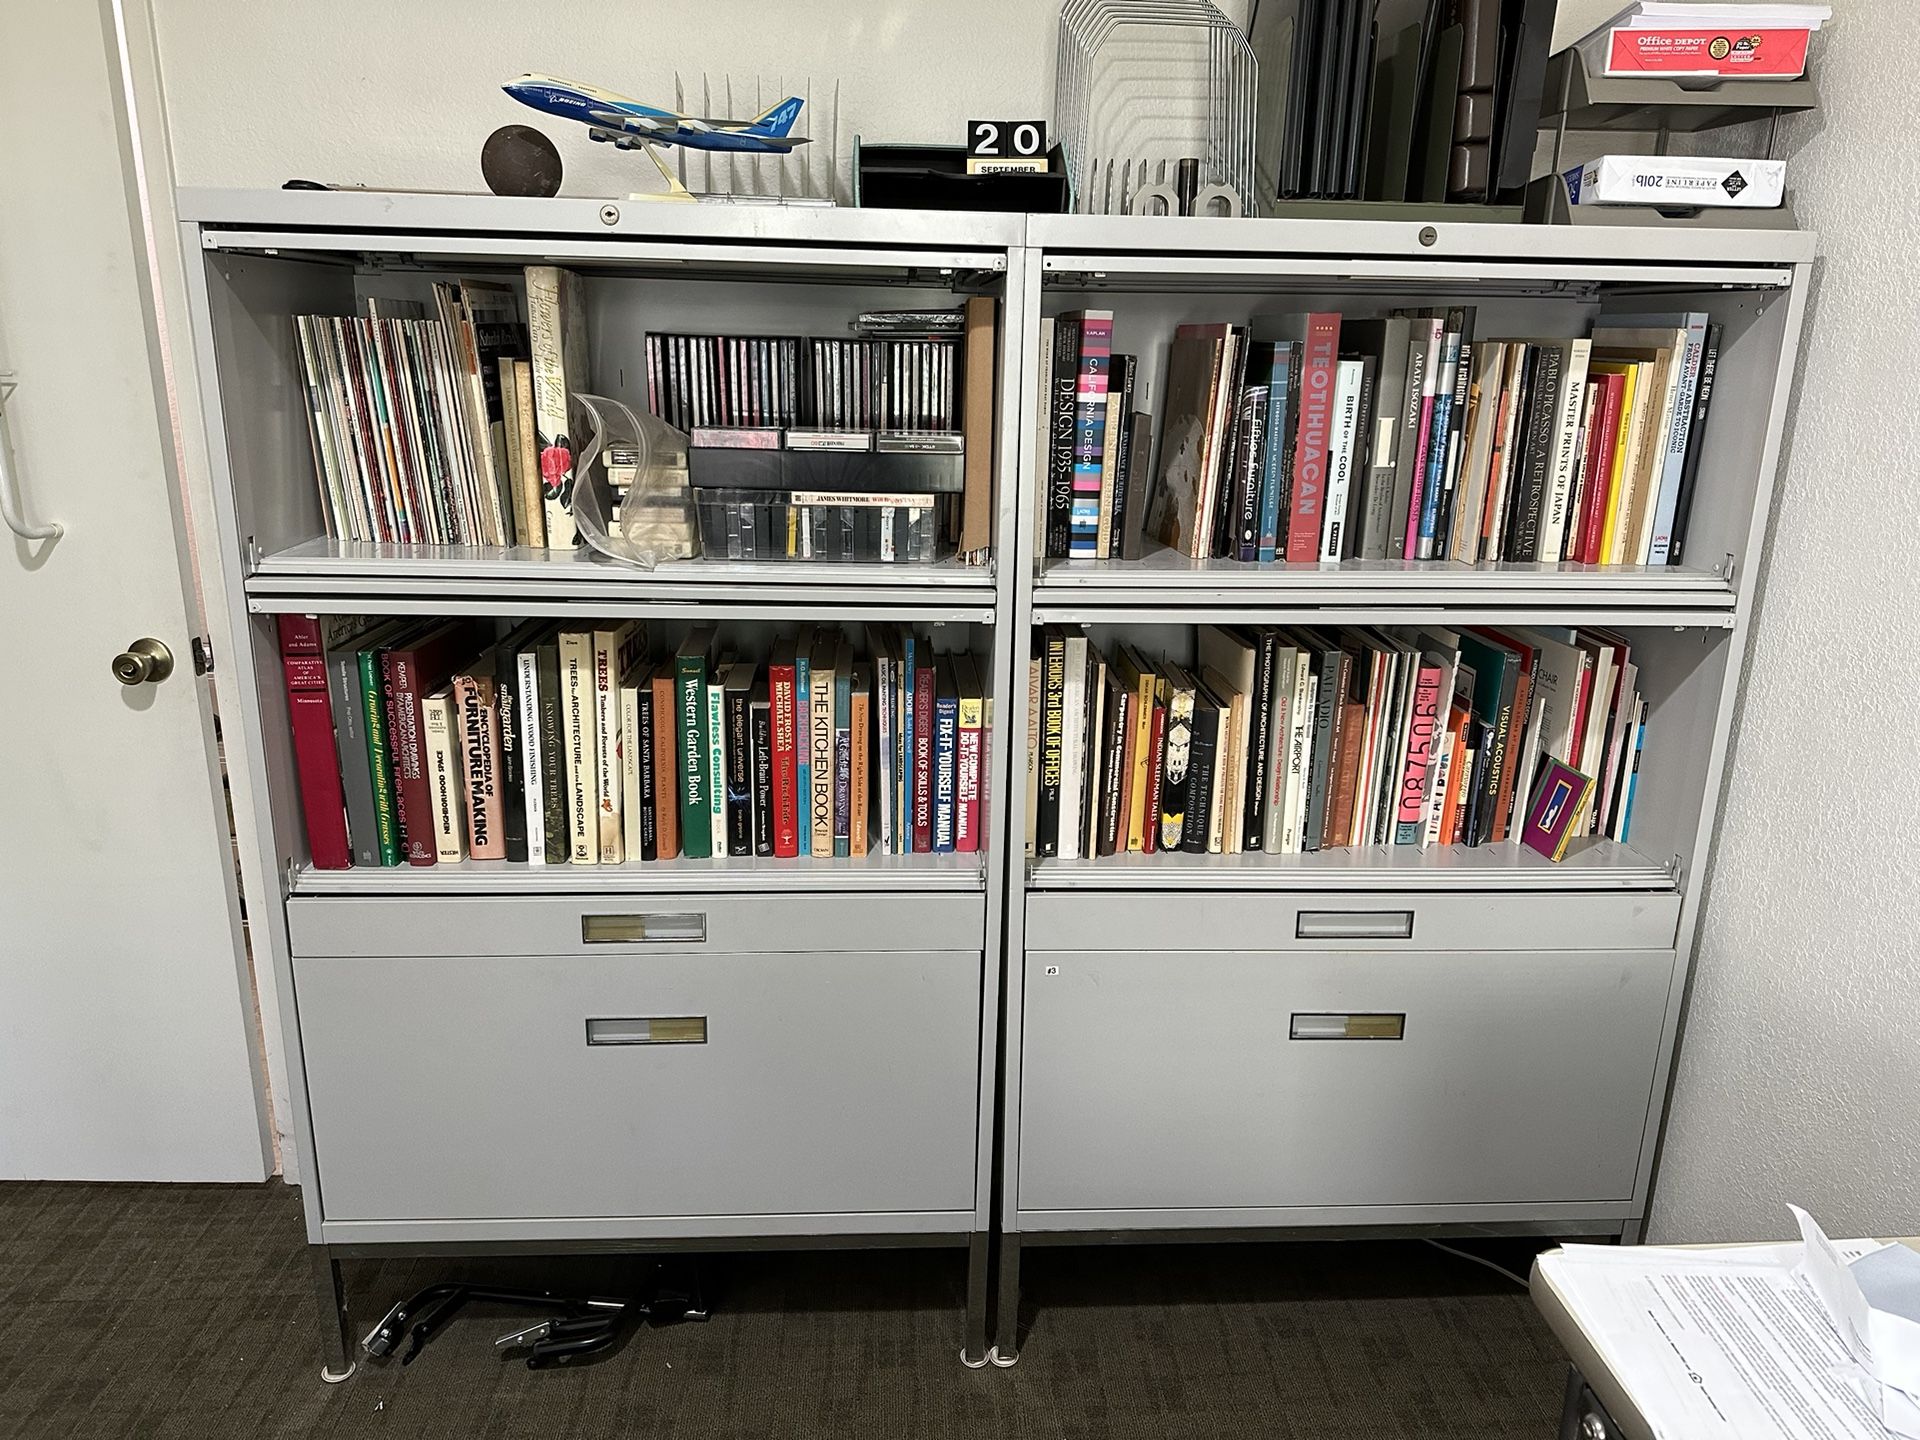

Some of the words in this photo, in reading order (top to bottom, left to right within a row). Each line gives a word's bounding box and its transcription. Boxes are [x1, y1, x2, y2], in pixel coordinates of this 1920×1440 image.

[1638, 37, 1672, 46] Office
[558, 97, 587, 107] BOEING
[767, 103, 797, 133] 747
[1636, 175, 1663, 188] 20lb
[533, 280, 562, 341] Flowers
[542, 339, 560, 357] of
[1684, 343, 1693, 365] FROM
[1688, 342, 1701, 379] CALDER
[1707, 348, 1717, 359] LET
[542, 356, 558, 376] the
[1412, 352, 1423, 386] ARATA
[1545, 354, 1559, 392] PABLO
[1703, 376, 1712, 384] BE
[1705, 359, 1715, 376] THERE
[542, 375, 565, 421] World
[1085, 358, 1098, 426] CALIFORNIA
[1676, 365, 1690, 417] AVANT-GARDE
[1686, 379, 1695, 392] and
[1701, 385, 1711, 401] NEON
[1058, 378, 1074, 439] DESIGN
[1343, 395, 1354, 429] BIRTH
[1407, 388, 1419, 429] ISOZAKI
[1537, 394, 1554, 447] PICASSO:
[1565, 381, 1580, 428] MASTER
[1298, 342, 1332, 515] TEOTIHUACAN
[1343, 430, 1349, 438] OF
[1674, 417, 1681, 427] TO
[1676, 393, 1693, 454] ABSTRACTION
[1082, 430, 1094, 470] DESIGN
[1536, 450, 1546, 459] A
[1559, 432, 1573, 472] PRINTS
[1669, 427, 1680, 454] ICONIC
[1336, 456, 1348, 484] COOL
[1557, 474, 1567, 489] OF
[1243, 462, 1259, 520] Furniture
[1522, 461, 1544, 556] RETROSPECTIVE
[1552, 492, 1564, 525] JAPAN
[1265, 638, 1273, 653] THE
[397, 660, 408, 690] KEMPER
[597, 650, 609, 692] TREES
[1048, 641, 1063, 690] INTERIORS
[1262, 653, 1272, 702] PHOTOGRAPHY
[1538, 668, 1558, 686] CHAIR
[396, 691, 404, 701] BY
[523, 659, 534, 722] UNDERSTANDING
[685, 679, 699, 727] Western
[815, 682, 828, 713] THE
[919, 674, 928, 710] READER'S
[1047, 691, 1062, 707] 3rd
[1261, 703, 1268, 711] OF
[1318, 665, 1335, 729] PALLADIO
[397, 700, 408, 738] AMERICAN
[404, 691, 417, 742] PRESENTATION
[545, 702, 555, 747] KNOWING
[642, 726, 649, 737] OF
[711, 692, 721, 745] Flawless
[735, 714, 744, 745] elegant
[919, 712, 928, 737] DIGEST
[1047, 710, 1061, 735] BOOK
[1116, 694, 1127, 735] Carpentry
[1497, 704, 1511, 741] VISUAL
[463, 686, 483, 780] FURNITURE
[480, 708, 493, 783] ENCYCLOPEDIA
[527, 724, 535, 747] WOOD
[798, 701, 809, 765] BACKPACKING
[815, 717, 828, 780] KITCHEN
[918, 738, 928, 759] BOOK
[969, 733, 978, 753] NEW
[1046, 736, 1061, 748] OF
[1115, 736, 1124, 744] in
[1257, 712, 1267, 761] ARCHITECTURE
[1294, 725, 1304, 739] THE
[400, 737, 412, 780] ARCHITECTS
[409, 742, 421, 780] DRAWINGS
[436, 750, 445, 773] SPACE
[528, 747, 537, 786] FINISHING
[548, 751, 556, 776] YOUR
[642, 739, 650, 764] SANTA
[687, 729, 701, 772] Garden
[736, 748, 744, 782] universe
[758, 746, 768, 784] Left-Brain
[918, 760, 927, 770] OF
[938, 719, 952, 802] FIX-IT-YOURSELF
[960, 732, 968, 802] DO-IT-YOURSELF
[1155, 737, 1163, 763] INDIAN
[1292, 740, 1303, 775] AIRPORT
[643, 765, 651, 799] BARBARA
[712, 748, 723, 814] Consulting
[918, 771, 927, 795] SKILLS
[968, 755, 978, 800] COMPLETE
[1045, 749, 1061, 786] OFFICES
[1112, 745, 1124, 790] Commercial
[1152, 763, 1161, 800] SLEEP-MAN
[1191, 763, 1199, 774] OF
[1200, 765, 1210, 782] THE
[1256, 762, 1264, 776] AND
[1488, 742, 1505, 796] ACOUSTICS
[439, 774, 451, 835] NEIGHBORHOOD
[485, 783, 494, 798] OF
[549, 779, 558, 809] TREES
[688, 775, 702, 805] Book
[759, 785, 769, 807] Power
[815, 783, 828, 827] BOOK
[1186, 777, 1197, 835] COMPOSITION
[1255, 777, 1263, 801] DESIGN
[471, 780, 488, 847] MAKING
[917, 804, 927, 826] TOOLS
[937, 804, 951, 847] MANUAL
[959, 803, 967, 839] MANUAL
[1109, 792, 1121, 842] Construction
[1150, 801, 1159, 822] TALES
[1196, 785, 1208, 836] TECHNIQUE
